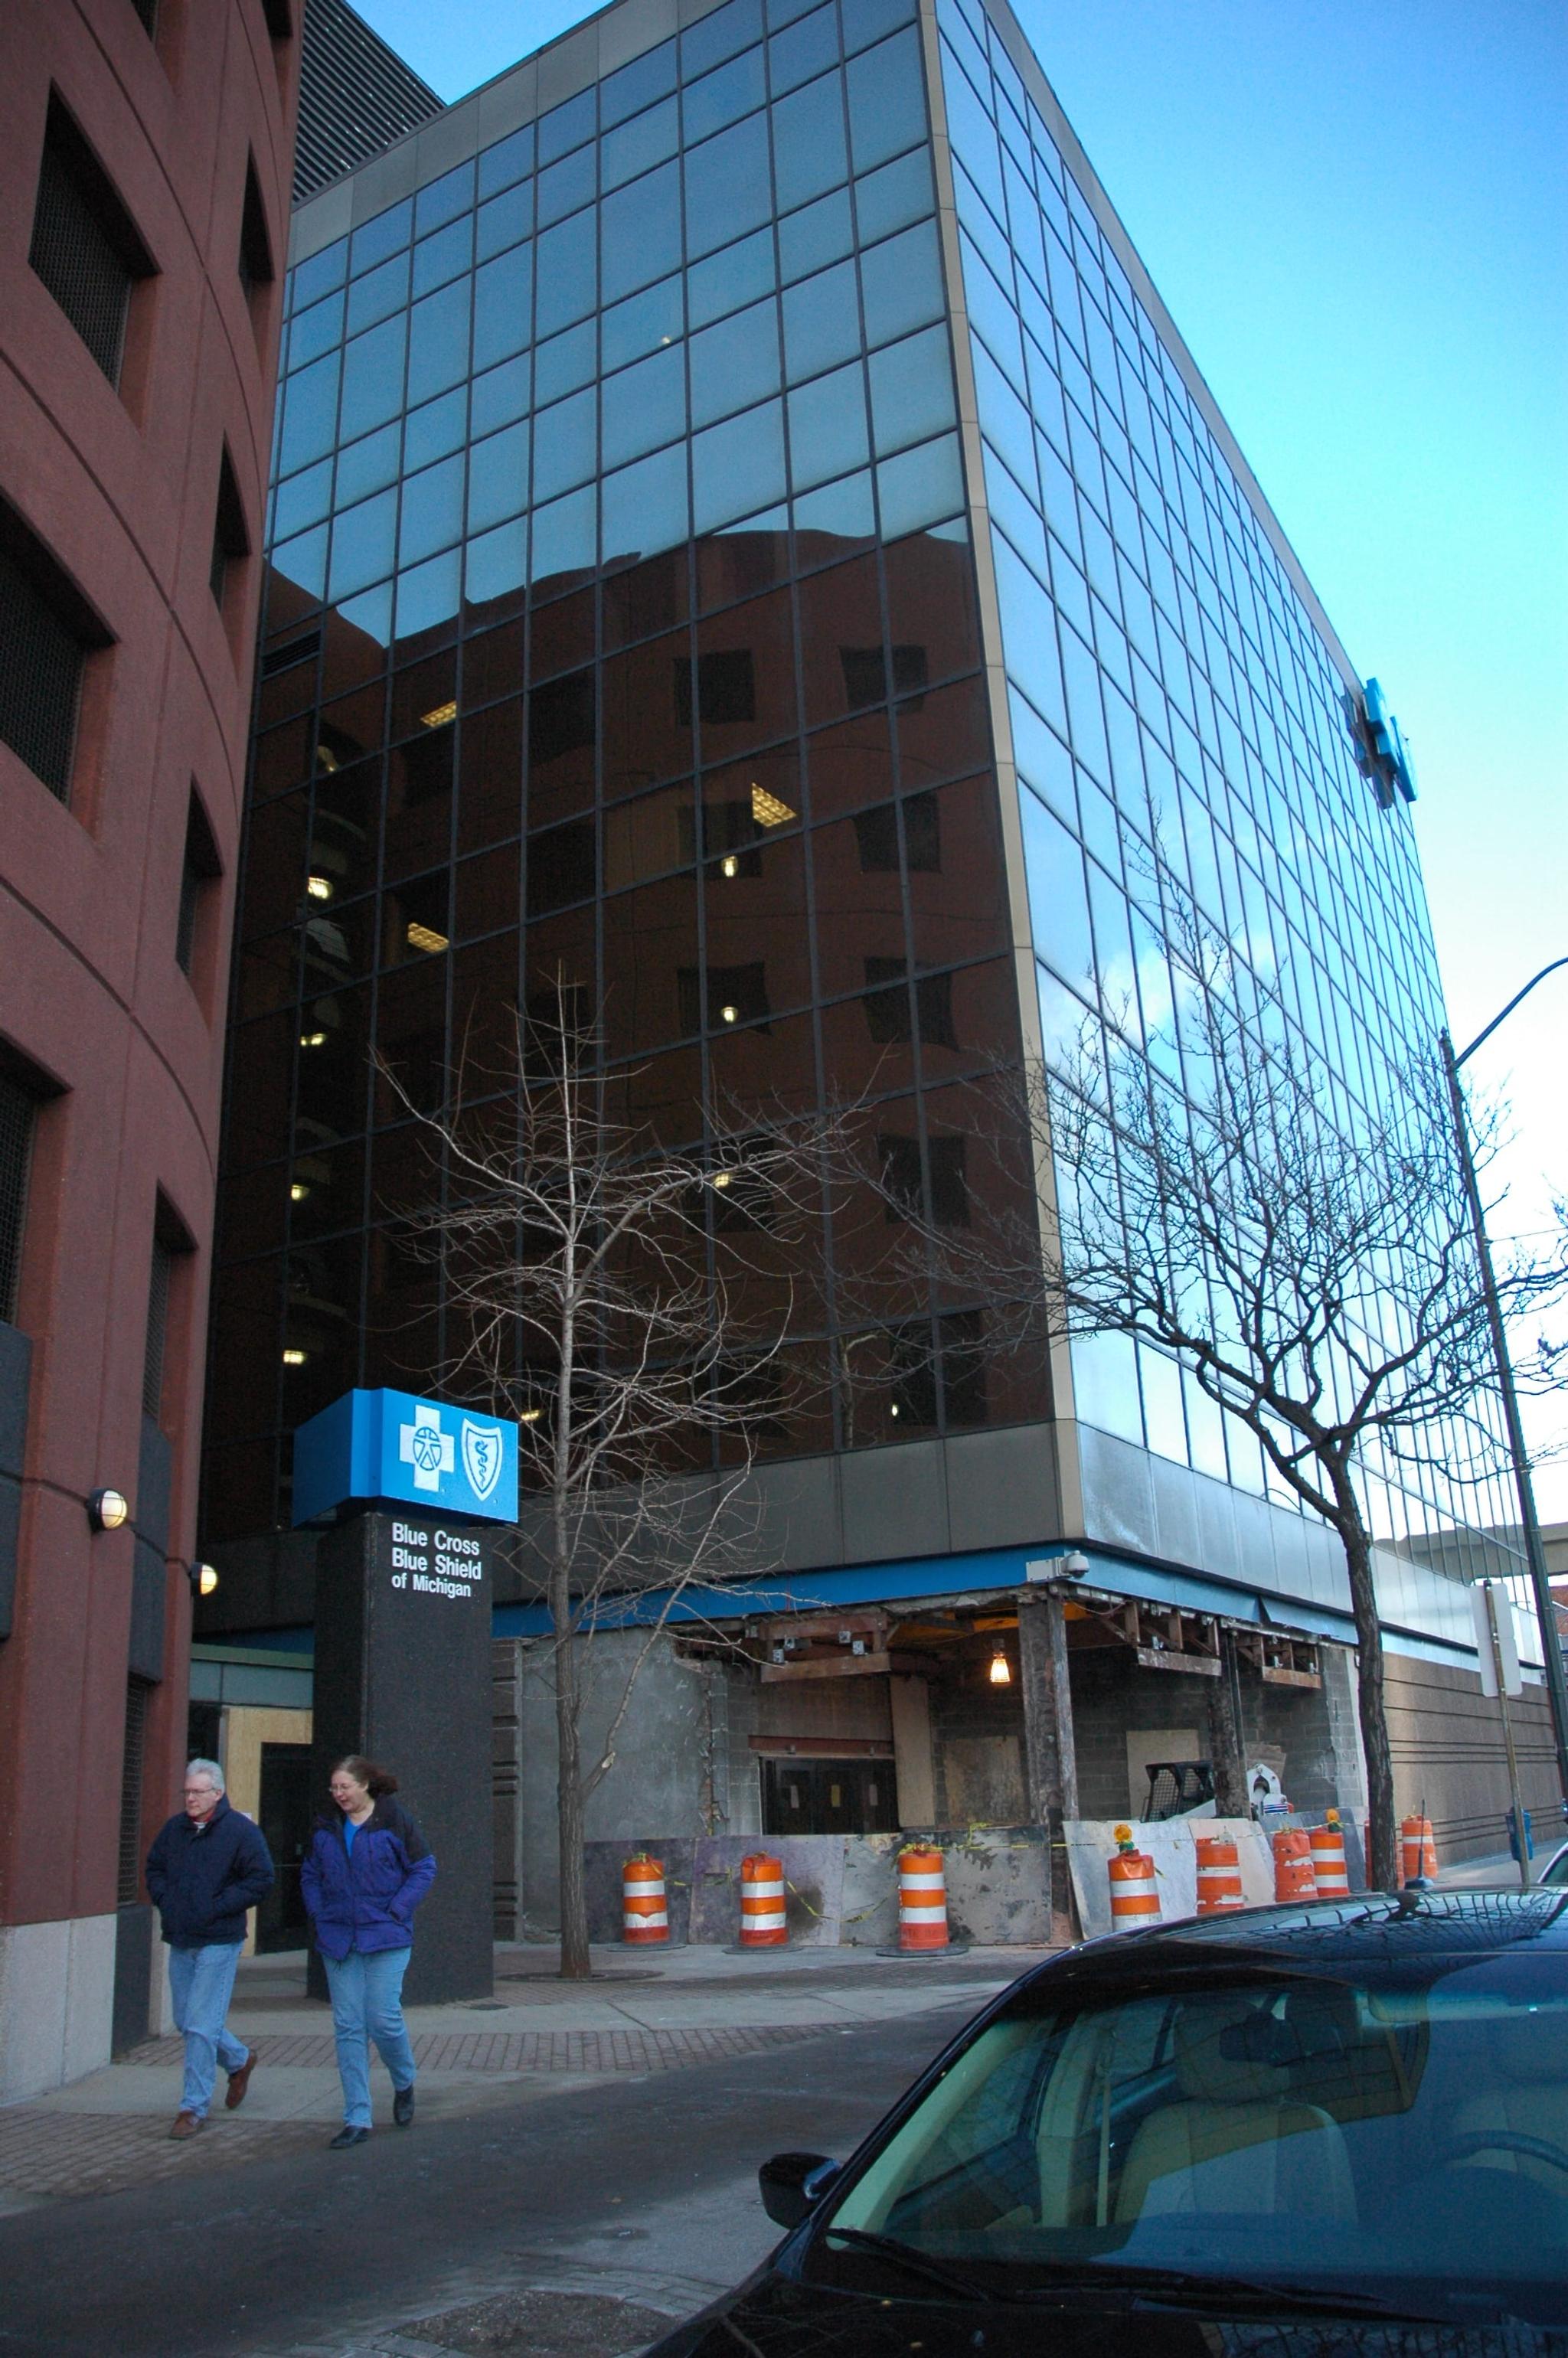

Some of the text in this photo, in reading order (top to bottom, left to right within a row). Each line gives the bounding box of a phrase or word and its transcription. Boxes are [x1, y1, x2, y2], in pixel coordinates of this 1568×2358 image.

[392, 1522, 480, 1556] Blue Cross
[392, 1547, 482, 1580] Blue Shield
[391, 1573, 472, 1599] of Michigan
